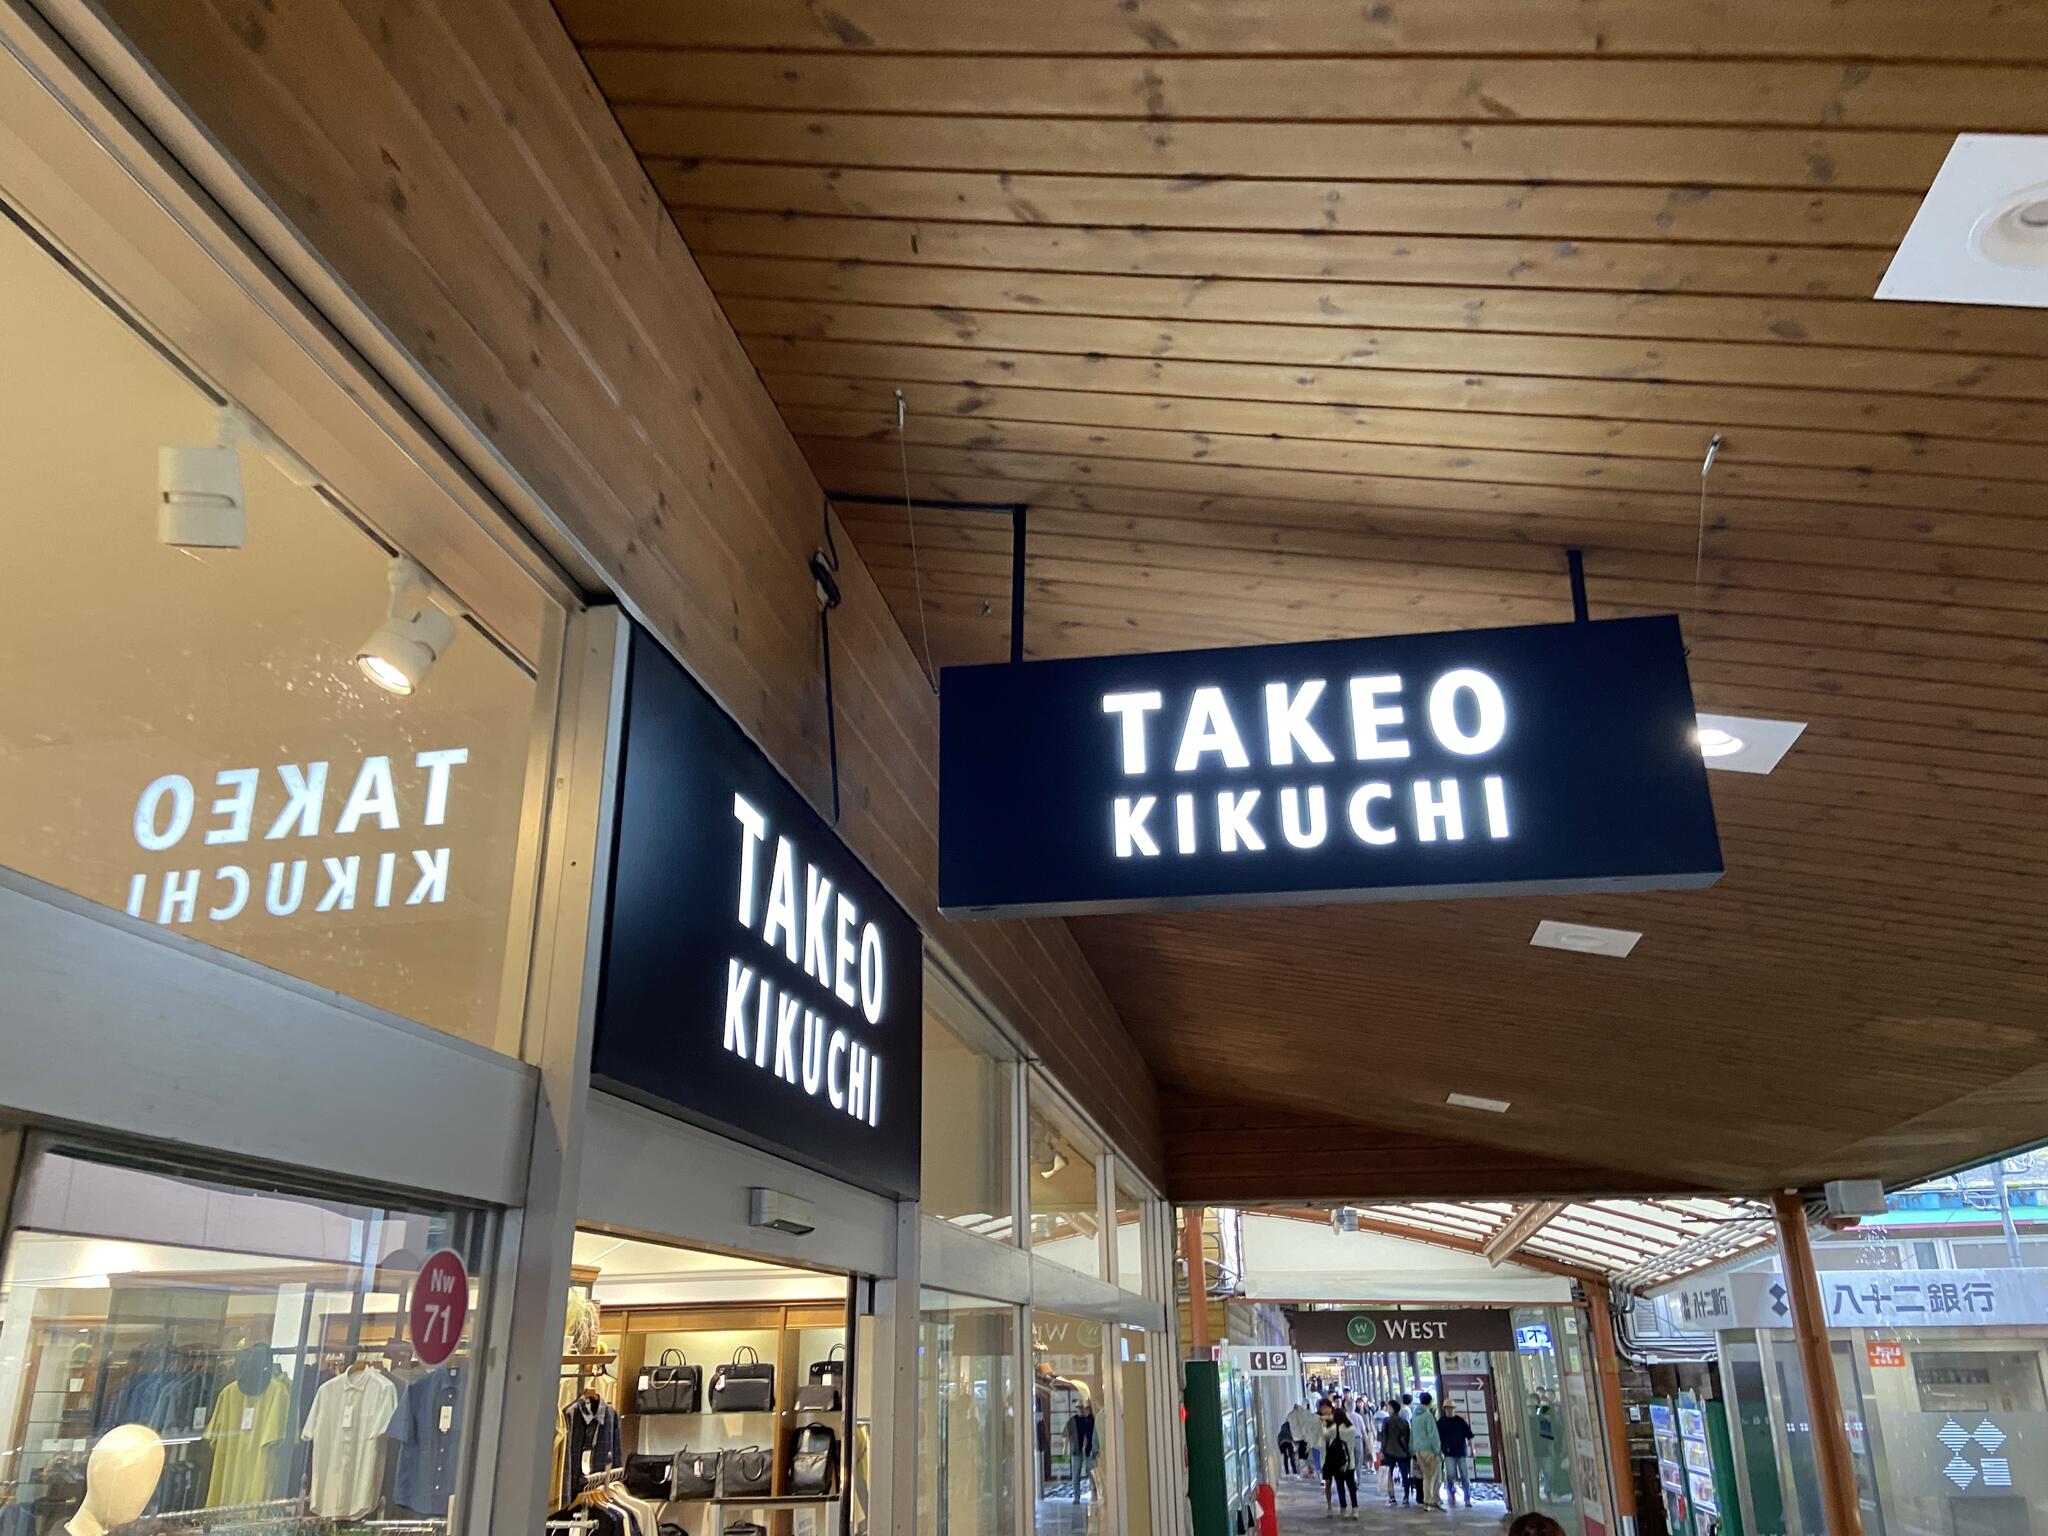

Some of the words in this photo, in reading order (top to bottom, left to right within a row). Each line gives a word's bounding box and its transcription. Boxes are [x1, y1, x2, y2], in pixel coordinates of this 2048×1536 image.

[1102, 668, 1507, 775] TAKEO
[1112, 776, 1510, 858] KIKUCHI
[733, 791, 883, 1025] TAKEO
[723, 957, 879, 1128] KIKUCHI
[423, 1304, 451, 1344] 71
[1383, 1318, 1448, 1340] WEST
[1833, 1282, 1995, 1315] 八十二銀行
